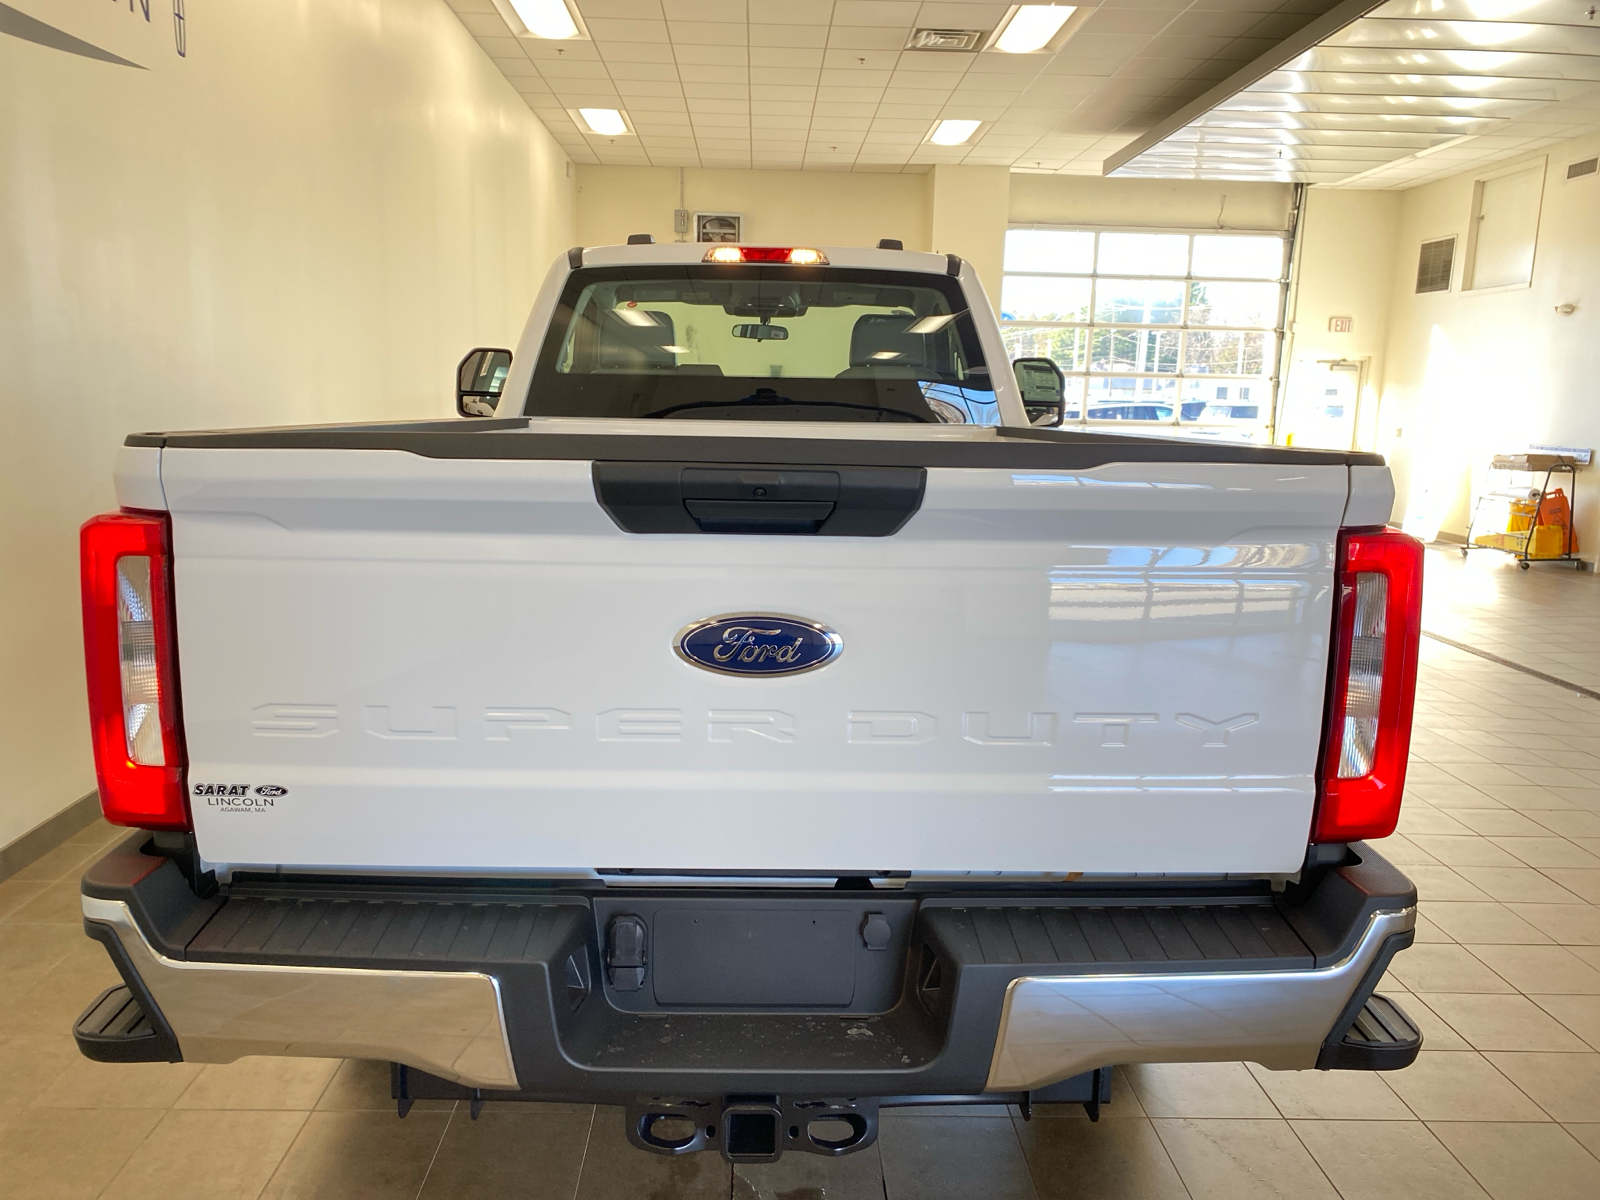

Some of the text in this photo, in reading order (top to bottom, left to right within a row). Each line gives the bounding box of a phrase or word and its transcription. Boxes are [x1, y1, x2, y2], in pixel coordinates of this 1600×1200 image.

[1334, 319, 1352, 333] EXIT
[713, 626, 804, 663] Ford
[251, 702, 1260, 748] SUPER DUTY
[194, 784, 250, 797] SARAT
[207, 798, 274, 807] LINCOLN
